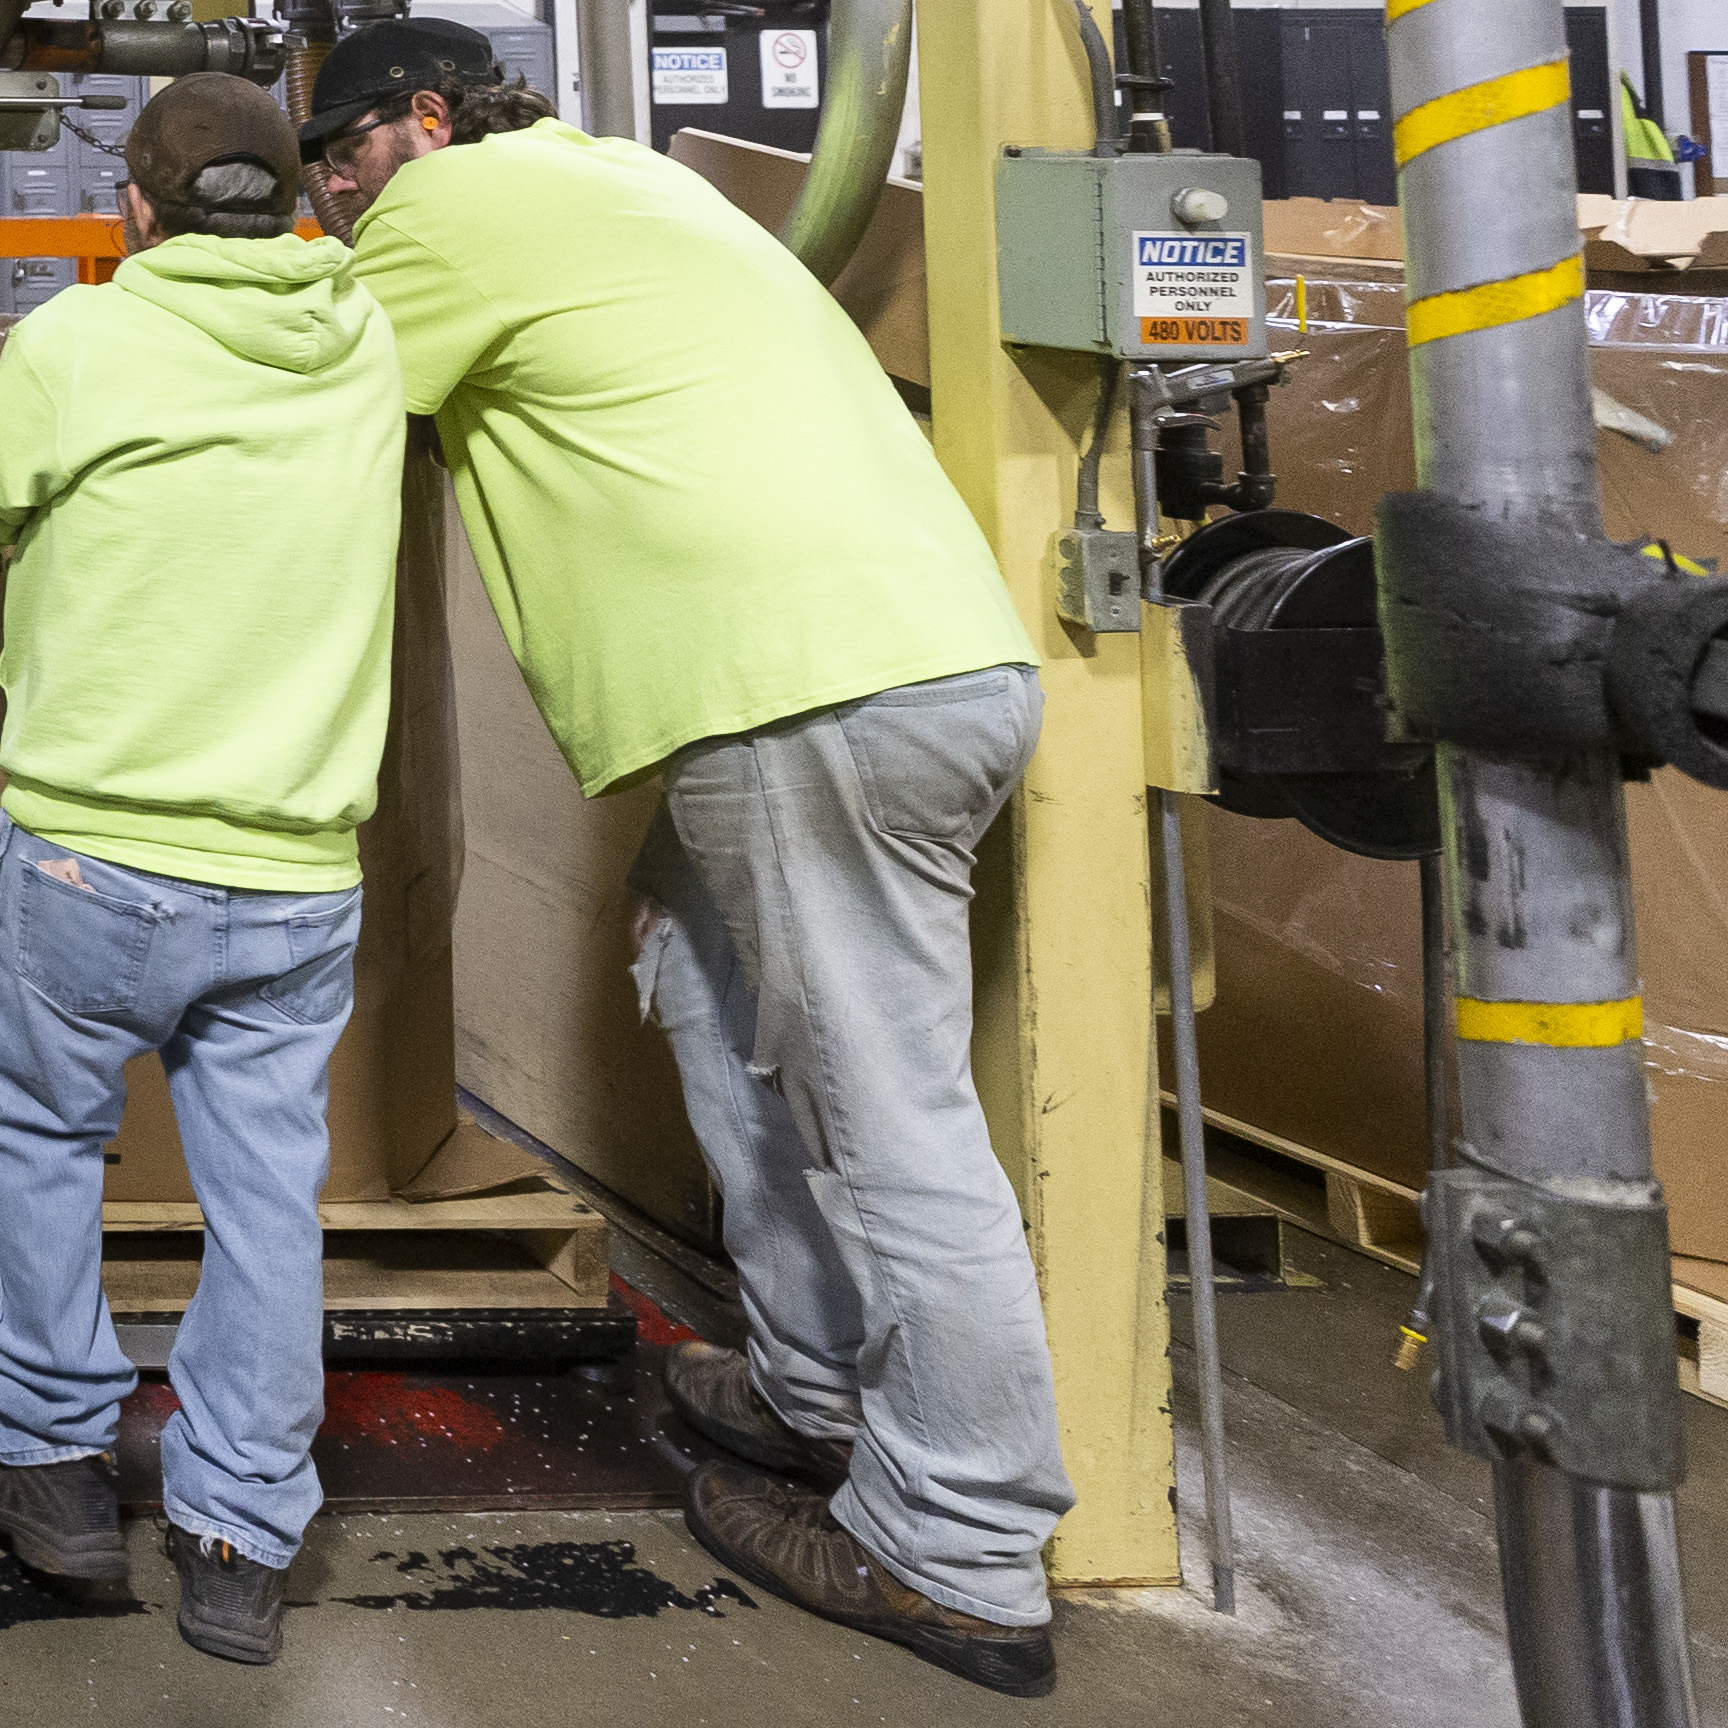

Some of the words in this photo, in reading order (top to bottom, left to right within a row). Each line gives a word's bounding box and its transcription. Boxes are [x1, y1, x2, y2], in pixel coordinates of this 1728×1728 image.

[655, 54, 722, 70] NOTICE
[663, 75, 715, 84] AUTHORIZED
[704, 85, 726, 94] ONLY
[1141, 240, 1242, 264] NOTICE
[1146, 272, 1239, 282] AUTHORIZED
[1149, 286, 1237, 297] PERSONNEL
[1175, 300, 1212, 311] ONLY
[1149, 320, 1179, 341] 480
[1185, 320, 1242, 342] VOLTS
